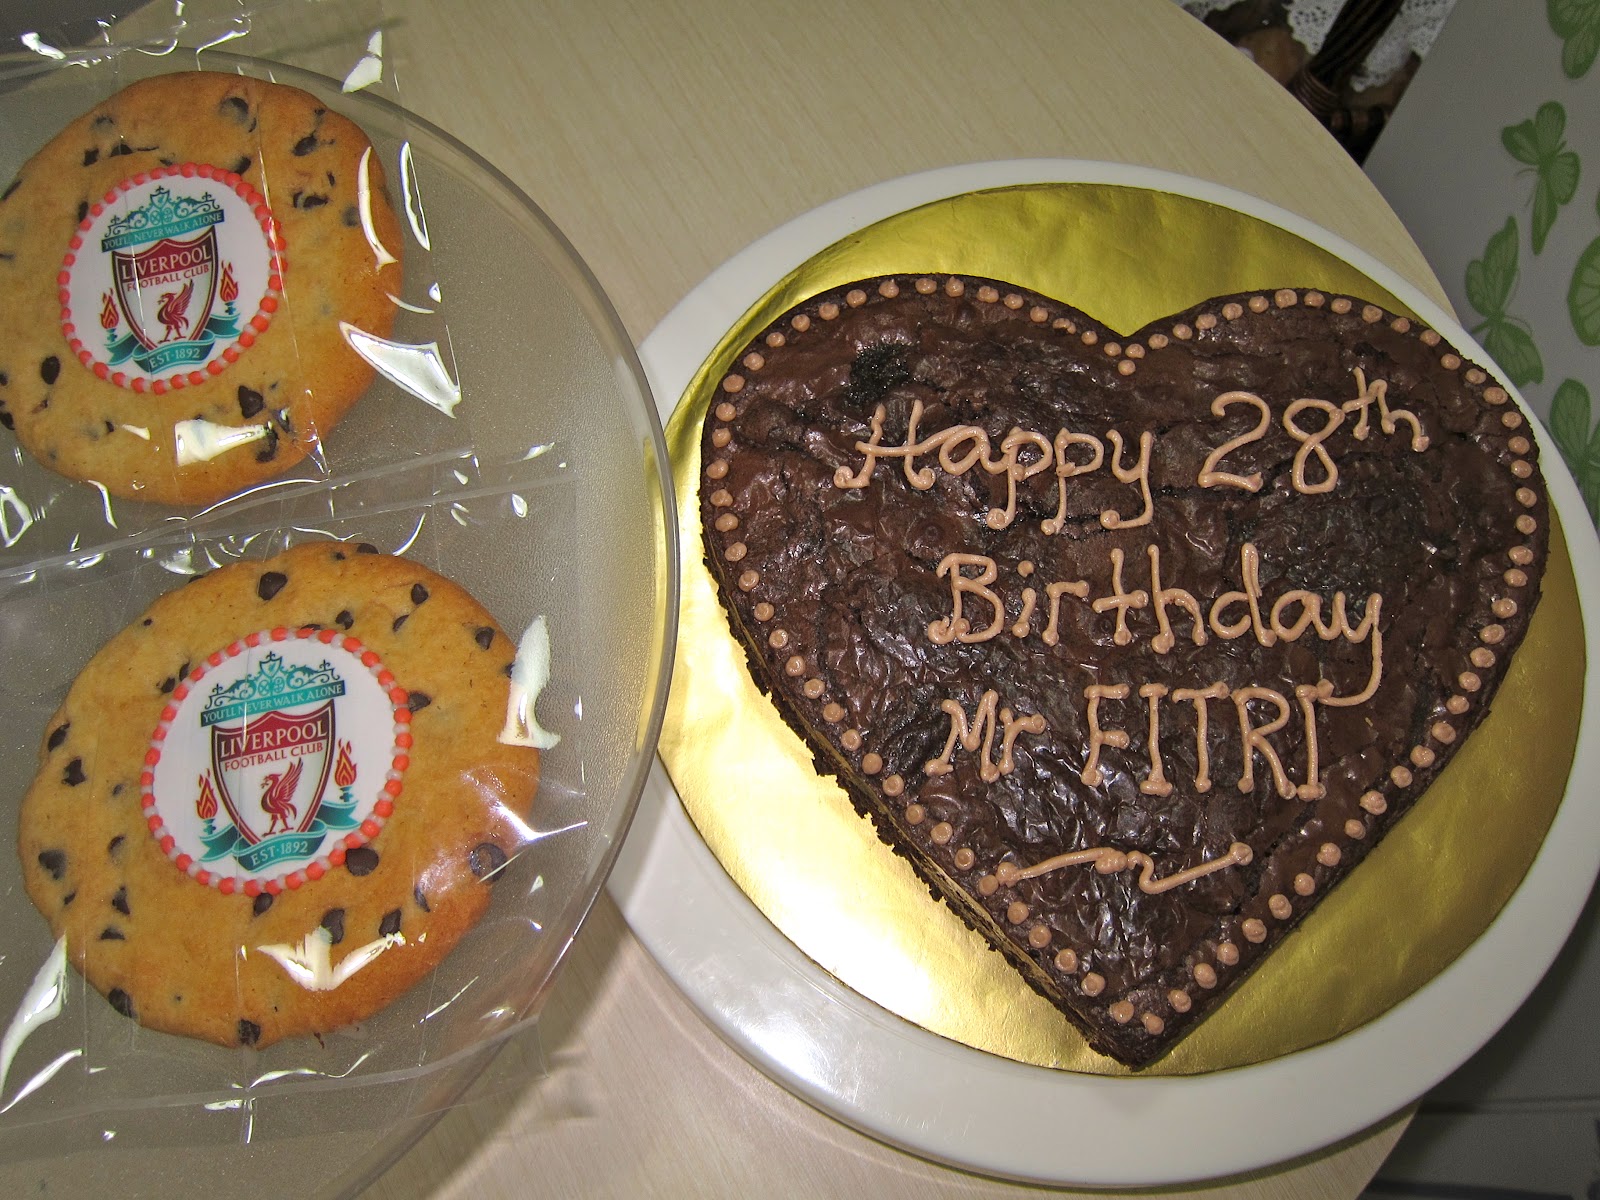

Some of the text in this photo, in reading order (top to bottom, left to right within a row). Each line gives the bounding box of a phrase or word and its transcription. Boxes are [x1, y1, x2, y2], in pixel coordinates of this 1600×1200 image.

[134, 228, 164, 243] NEVER
[121, 245, 212, 280] LIVERPOOL
[127, 264, 210, 292] FOOTBALL CLUB
[833, 398, 1154, 536] Happy
[927, 543, 1384, 708] Birthday
[239, 700, 273, 716] NEVER
[273, 692, 307, 709] WALK
[307, 683, 343, 699] ALONE
[220, 719, 328, 759] LIVERPOOL
[924, 680, 1334, 801] Mr FITRI
[224, 742, 323, 772] FOOTBALL CLUB
